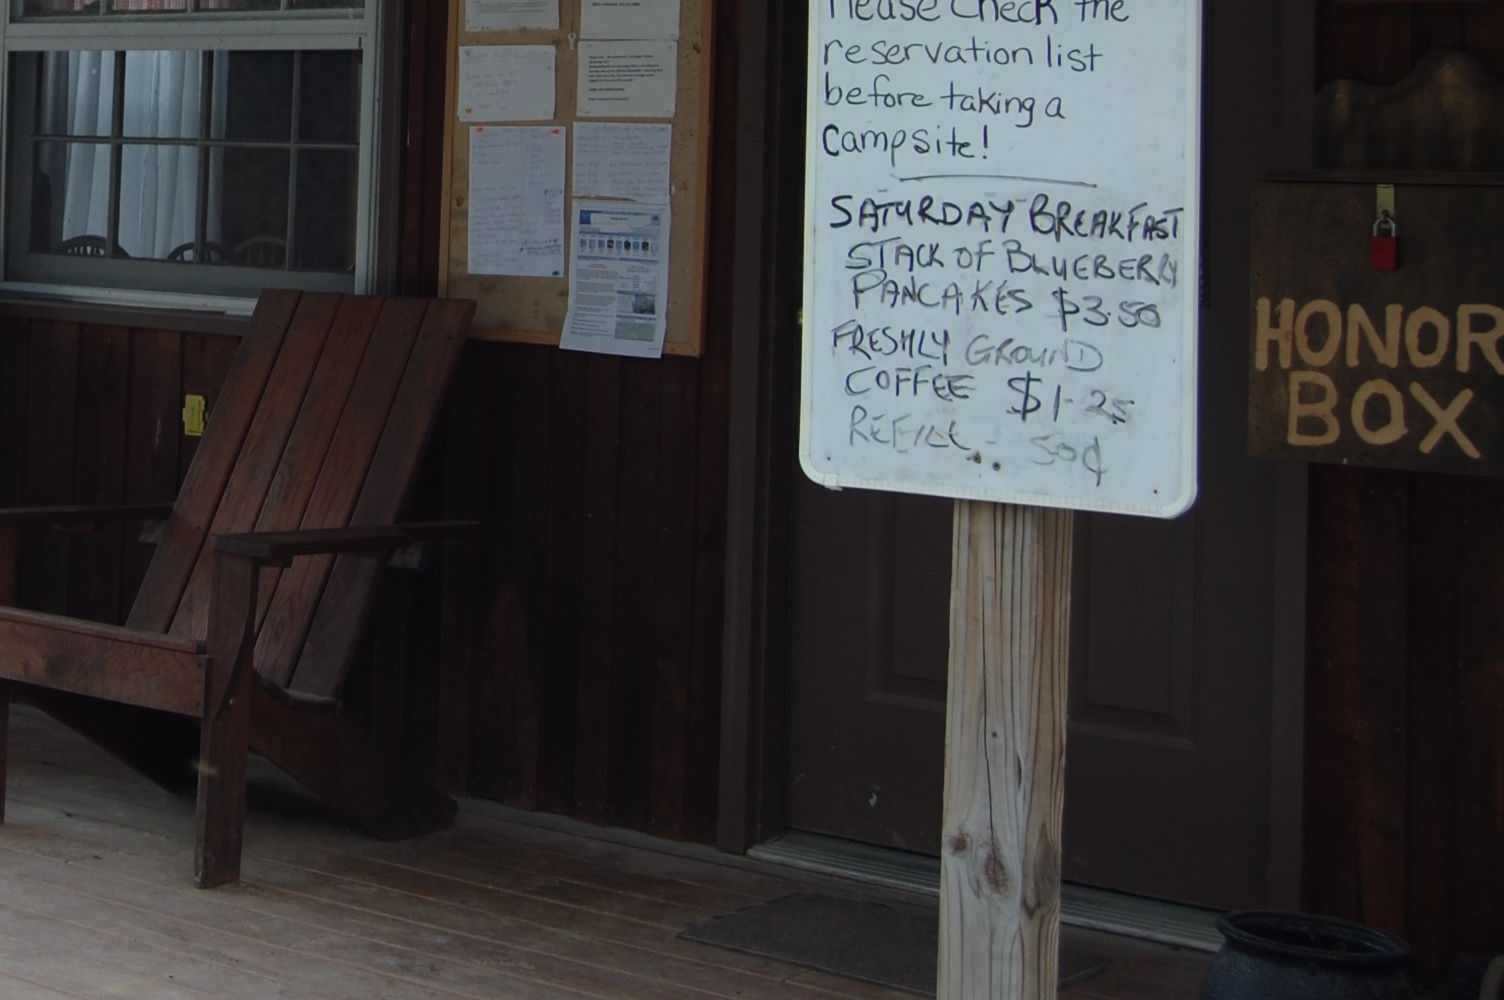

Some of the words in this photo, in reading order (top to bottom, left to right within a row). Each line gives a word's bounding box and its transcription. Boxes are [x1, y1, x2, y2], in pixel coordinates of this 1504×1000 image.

[823, 36, 1034, 68] reservation
[1046, 35, 1103, 72] list
[824, 72, 934, 108] before
[940, 81, 1036, 128] taking
[1044, 95, 1066, 120] a
[829, 194, 1016, 234] SATURDAY
[1028, 193, 1185, 243] BREAKFAST
[845, 236, 945, 272] STACK
[954, 240, 995, 272] OF
[1001, 238, 1179, 288] BLUEBERRY
[849, 268, 1033, 315] PANCAKES
[831, 319, 951, 366] FRESHLY
[965, 334, 1104, 373] GROUND
[1254, 297, 1504, 376] HONOR
[844, 364, 976, 402] COFFEE
[1287, 370, 1481, 459] BOX
